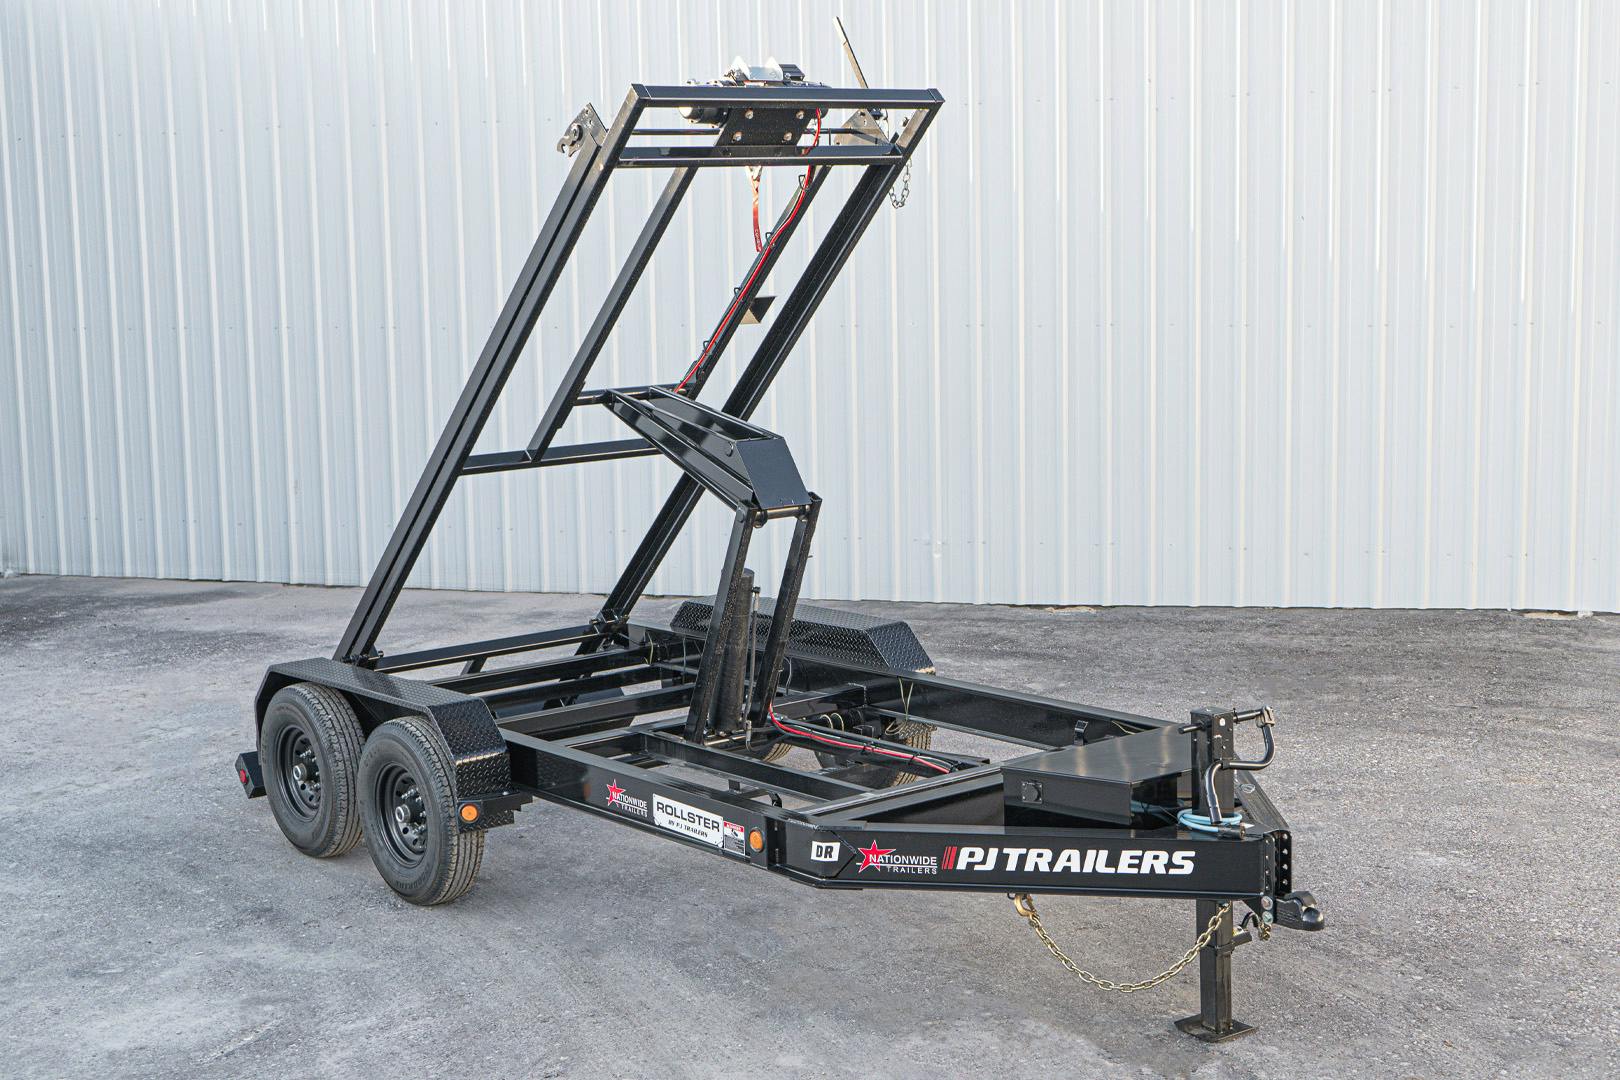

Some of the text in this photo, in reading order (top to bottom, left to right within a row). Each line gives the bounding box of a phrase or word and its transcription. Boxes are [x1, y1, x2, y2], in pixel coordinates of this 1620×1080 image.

[612, 792, 648, 809] NATIONWIDE
[656, 801, 720, 832] ROLLSTER
[684, 824, 708, 838] TRAILERS
[816, 845, 834, 859] DR
[869, 854, 937, 866] NATIONWIDE
[956, 846, 1196, 875] PJ TRAILERS
[886, 866, 937, 875] TRAILERS
